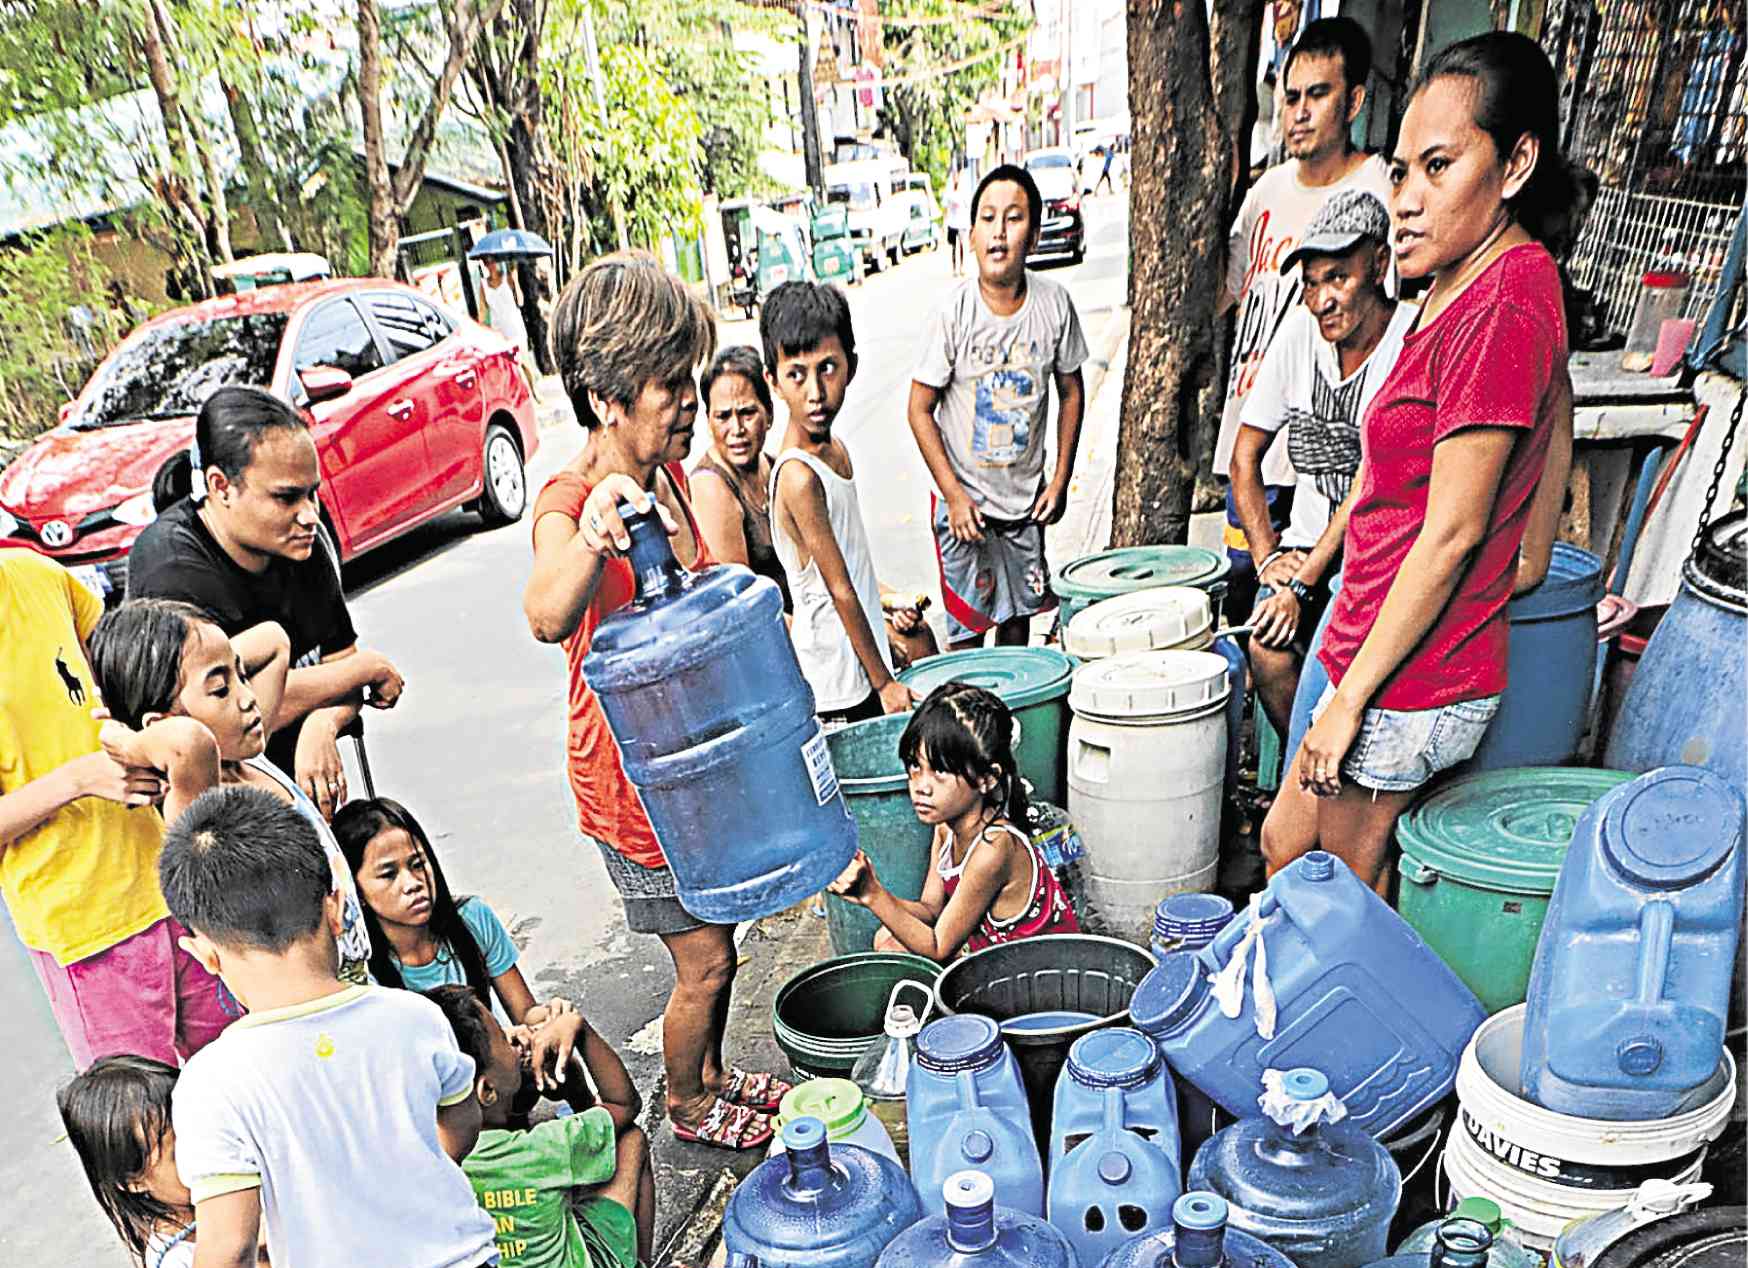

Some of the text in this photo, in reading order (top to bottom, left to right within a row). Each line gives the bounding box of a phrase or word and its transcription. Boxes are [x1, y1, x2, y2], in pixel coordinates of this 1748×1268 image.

[1465, 1112, 1561, 1178] DAVIES
[484, 1188, 537, 1209] BIBLE
[496, 1240, 527, 1259] HIP
